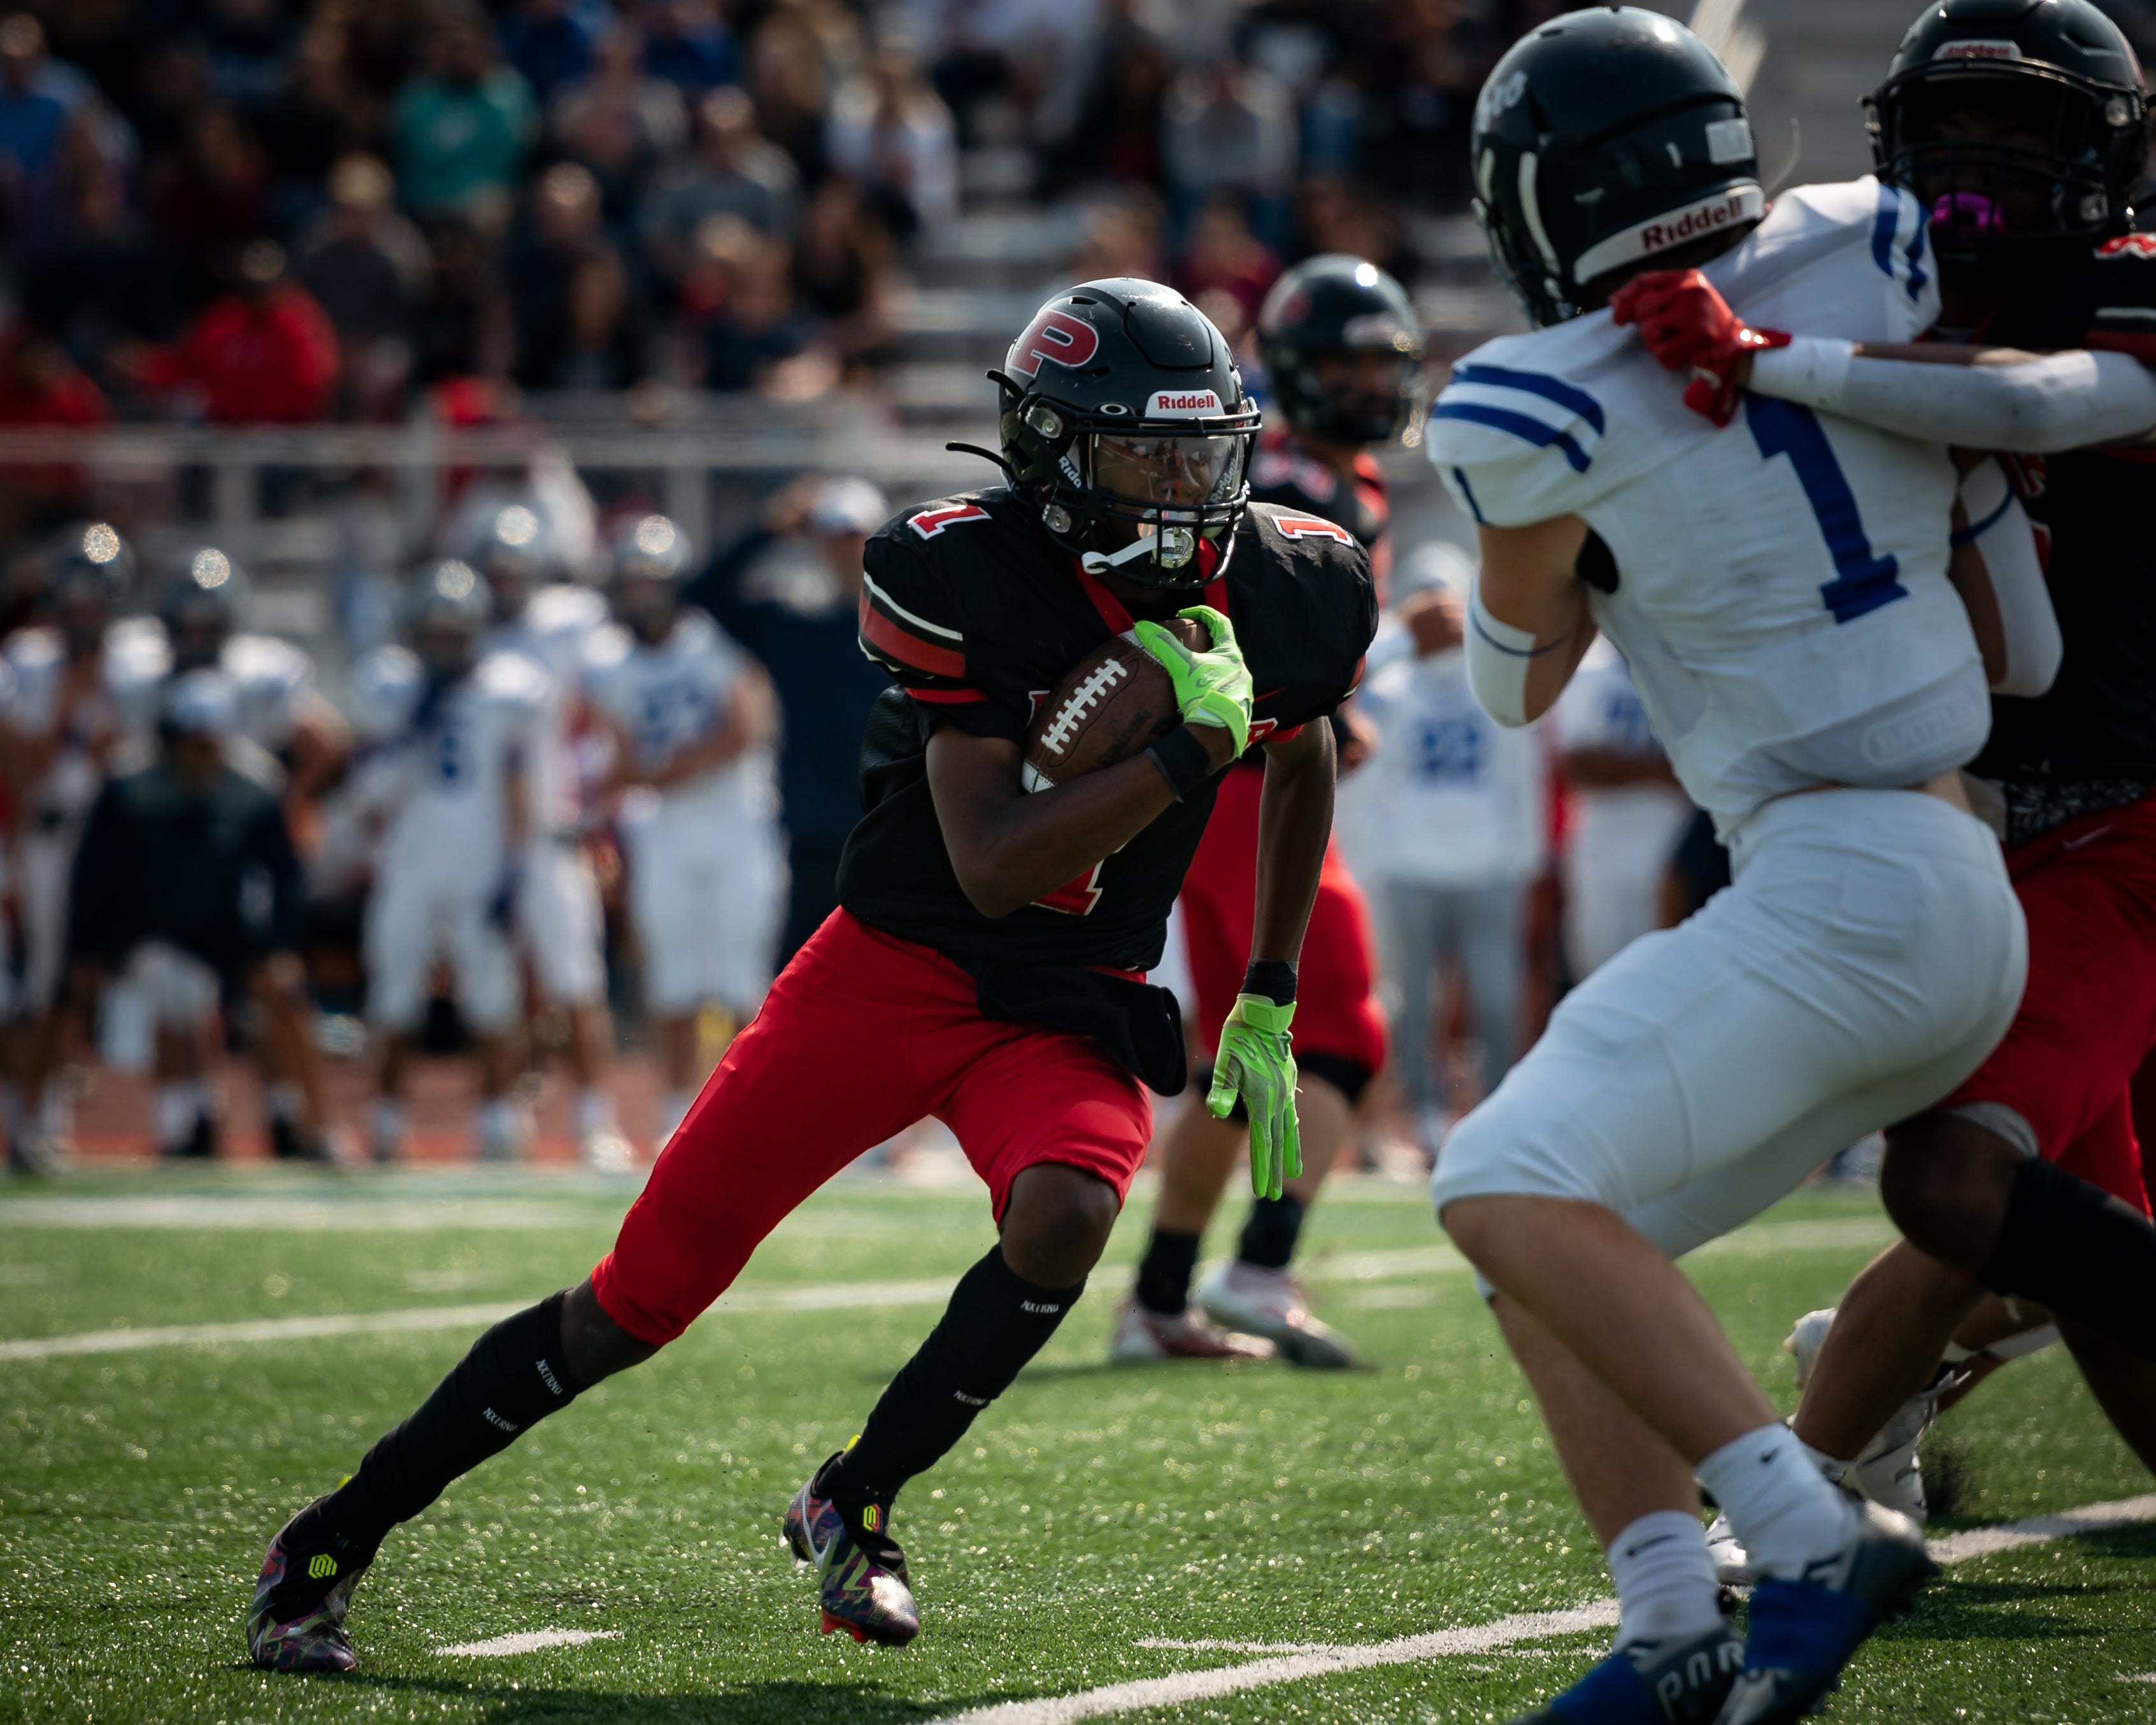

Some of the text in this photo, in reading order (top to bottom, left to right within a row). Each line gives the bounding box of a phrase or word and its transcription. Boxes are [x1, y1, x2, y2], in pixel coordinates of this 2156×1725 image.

[1641, 196, 1743, 250] Riddell
[1009, 309, 1099, 378] P
[1158, 394, 1215, 409] Riddell
[1210, 457, 1237, 504] Riddell
[906, 505, 992, 540] 1
[1270, 515, 1353, 547] 1
[1744, 390, 1910, 626] 1
